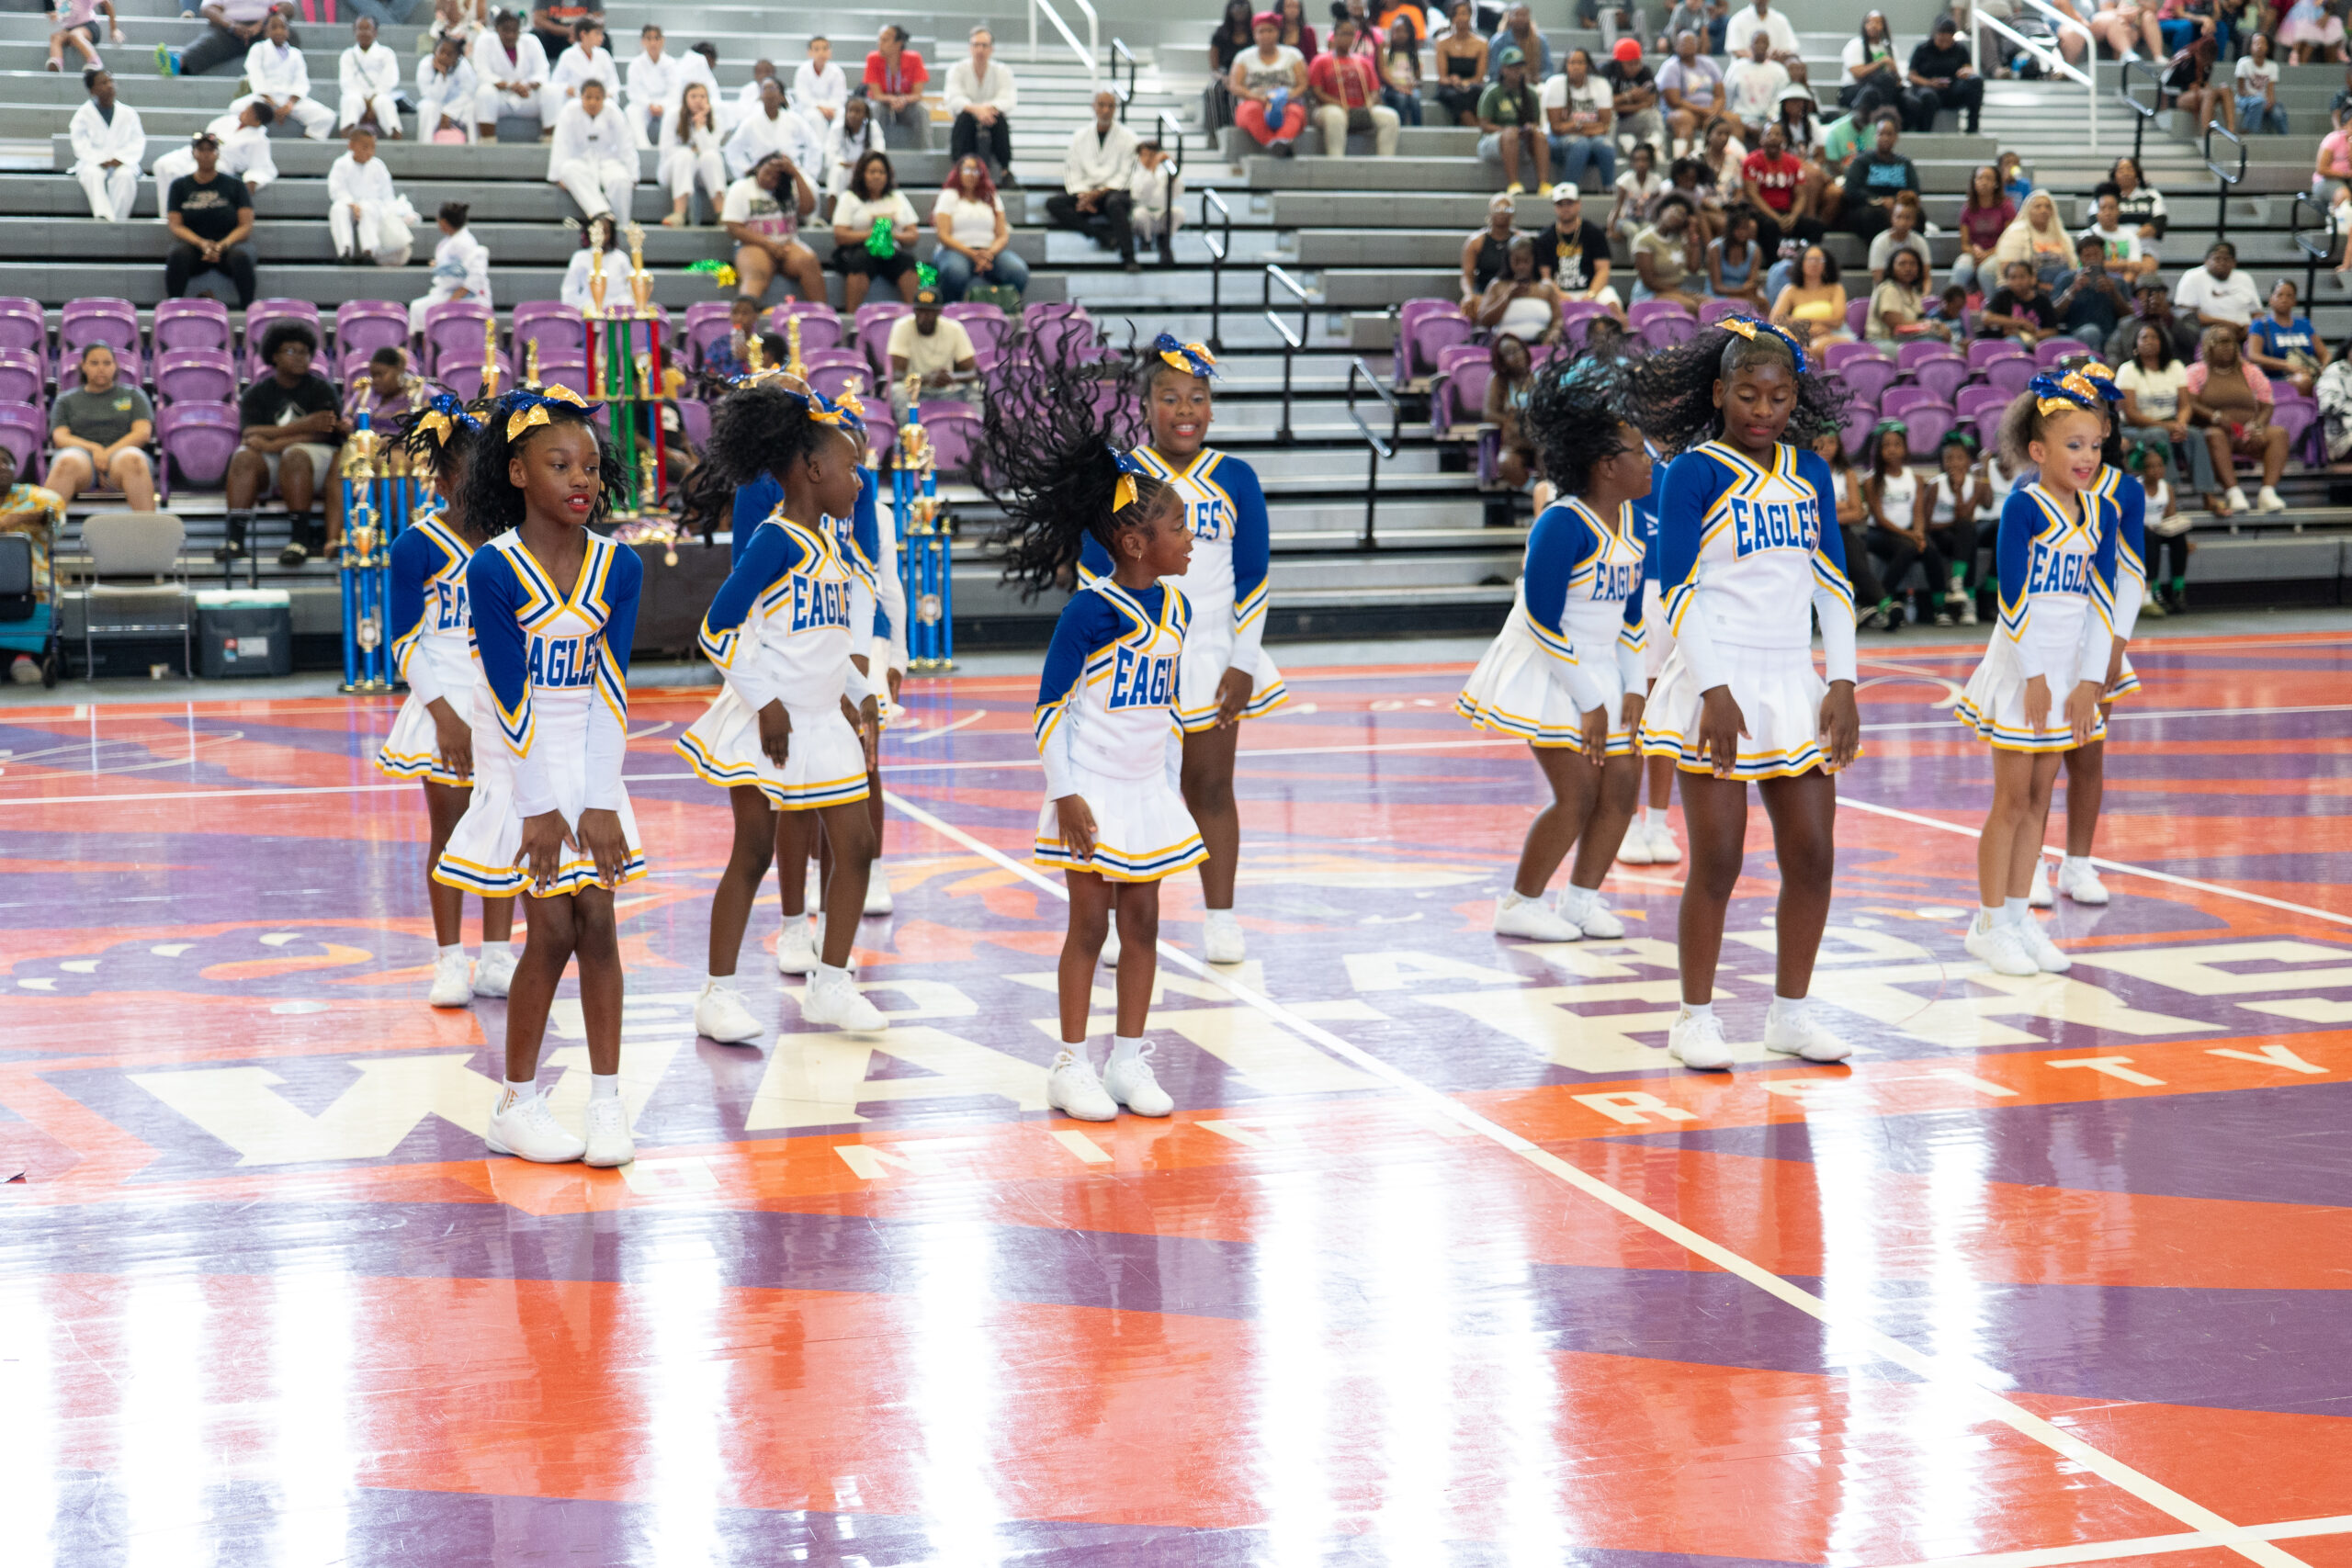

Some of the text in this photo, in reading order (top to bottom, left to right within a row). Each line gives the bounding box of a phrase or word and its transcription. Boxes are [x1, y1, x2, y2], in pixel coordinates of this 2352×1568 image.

[1730, 497, 1819, 558] EAGLES
[792, 574, 852, 632] EAGLE
[523, 629, 604, 686] AGLE
[1109, 645, 1181, 708] EAGL
